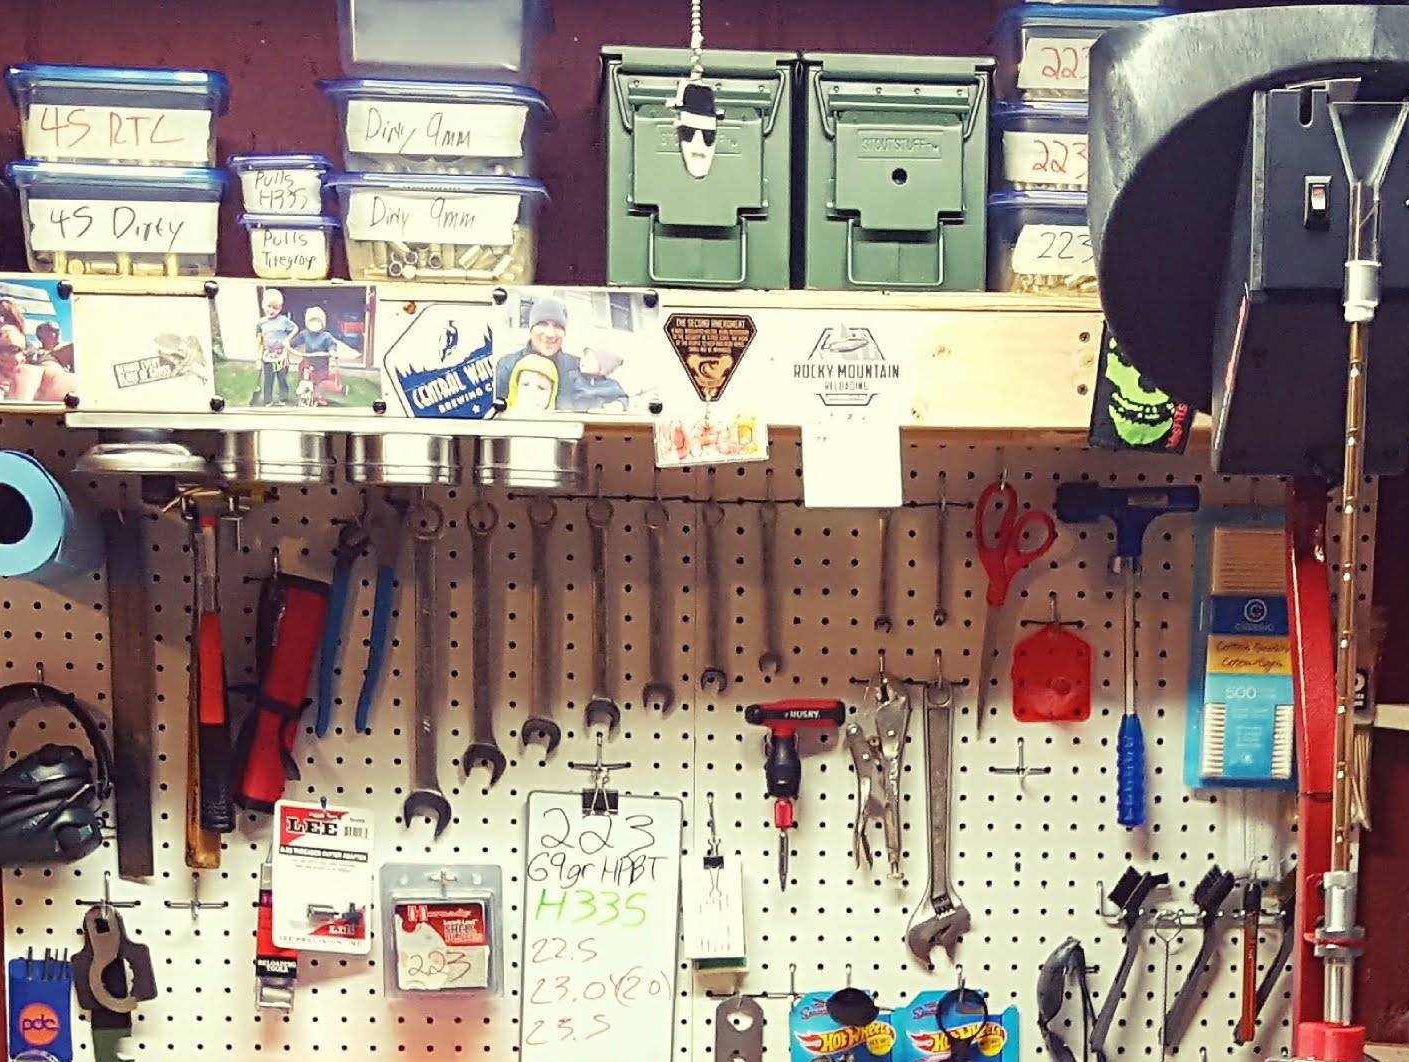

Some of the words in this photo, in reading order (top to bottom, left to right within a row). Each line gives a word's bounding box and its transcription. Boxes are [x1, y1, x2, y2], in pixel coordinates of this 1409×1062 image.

[39, 108, 91, 146] 45
[427, 112, 472, 147] 9mm
[255, 171, 295, 188] Pulls
[50, 208, 93, 240] 45
[113, 206, 183, 241] Dirty
[432, 196, 477, 229] 9mm
[263, 230, 308, 248] Pulls
[793, 364, 833, 379] ROCKY
[838, 364, 899, 379] MOUNTAIN
[413, 371, 467, 409] CENTRAL
[790, 710, 821, 719] HUSKY
[288, 817, 339, 837] LEE
[540, 808, 656, 856] 223
[535, 888, 647, 927] H335
[257, 959, 296, 969] RELOADING
[408, 951, 473, 983] 223
[21, 1013, 59, 1036] pdc
